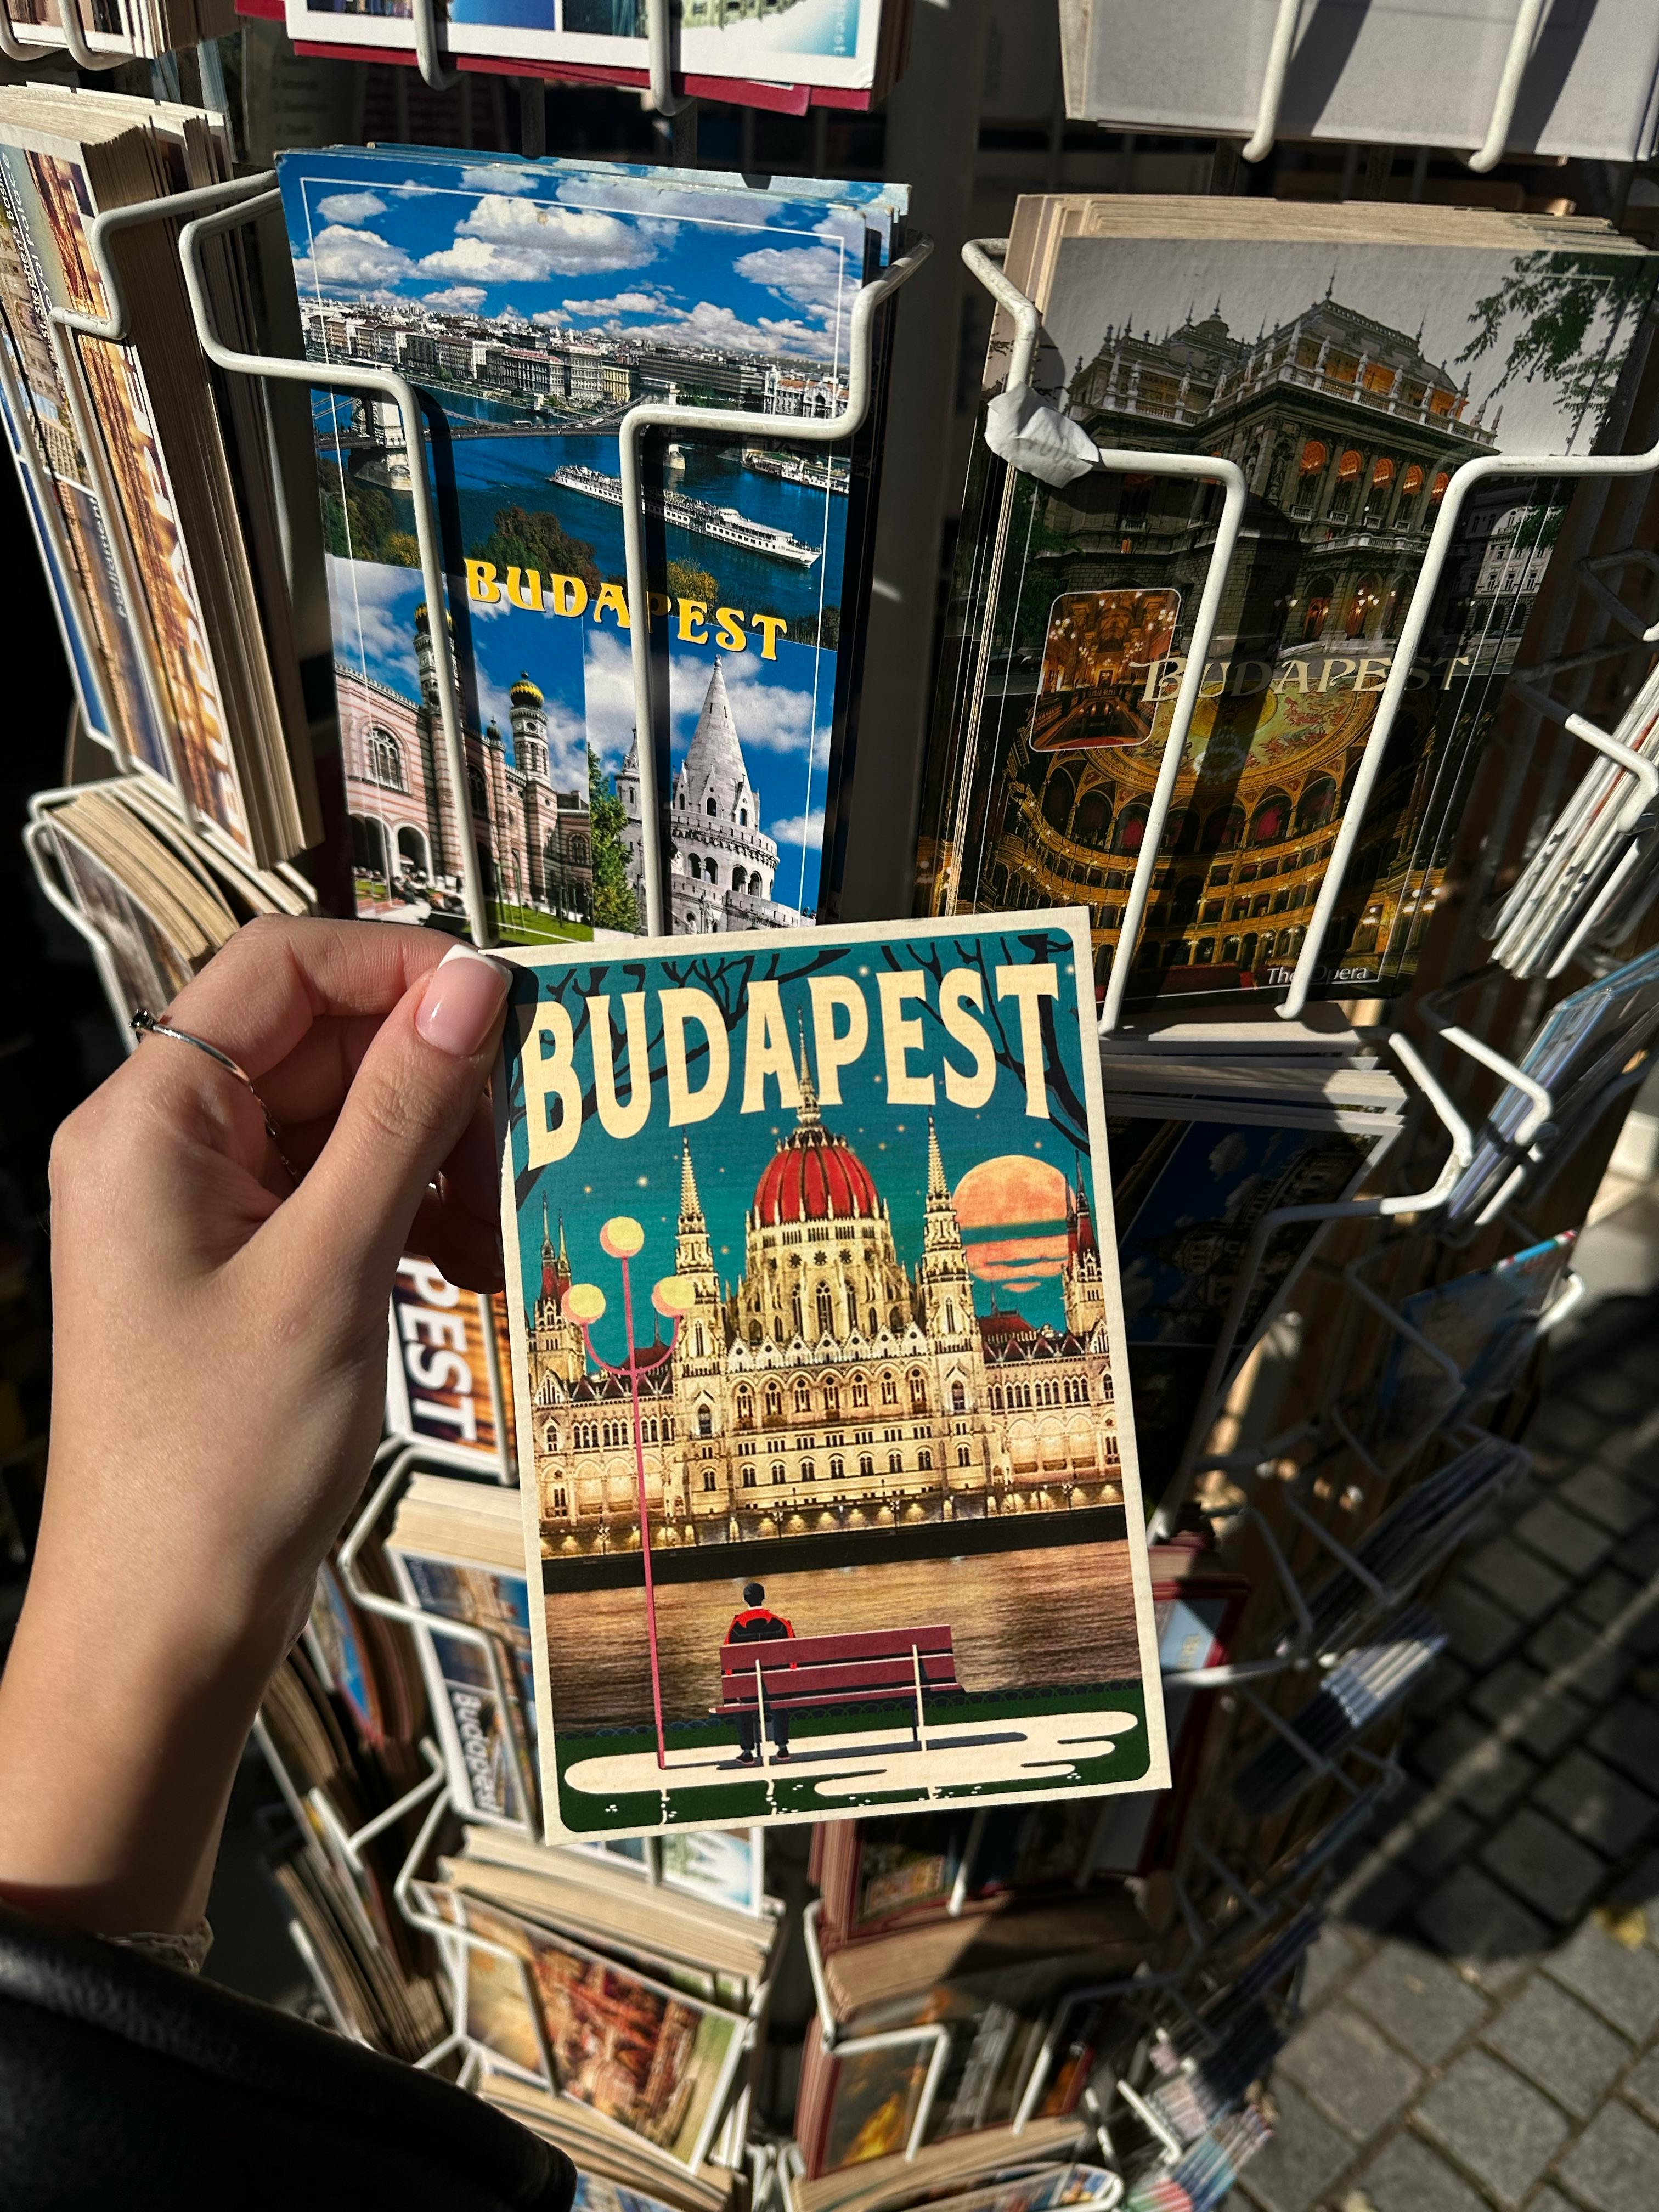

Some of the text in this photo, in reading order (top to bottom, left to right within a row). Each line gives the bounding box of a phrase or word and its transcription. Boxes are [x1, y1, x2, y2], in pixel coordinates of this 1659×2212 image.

[2, 152, 53, 309] oyal Palace
[12, 225, 43, 315] Stephen's
[464, 558, 787, 661] BUDAPEST
[1129, 656, 1469, 702] BUDAPEST
[1312, 965, 1369, 985] Opera
[515, 962, 1059, 1171] BUDAPEST
